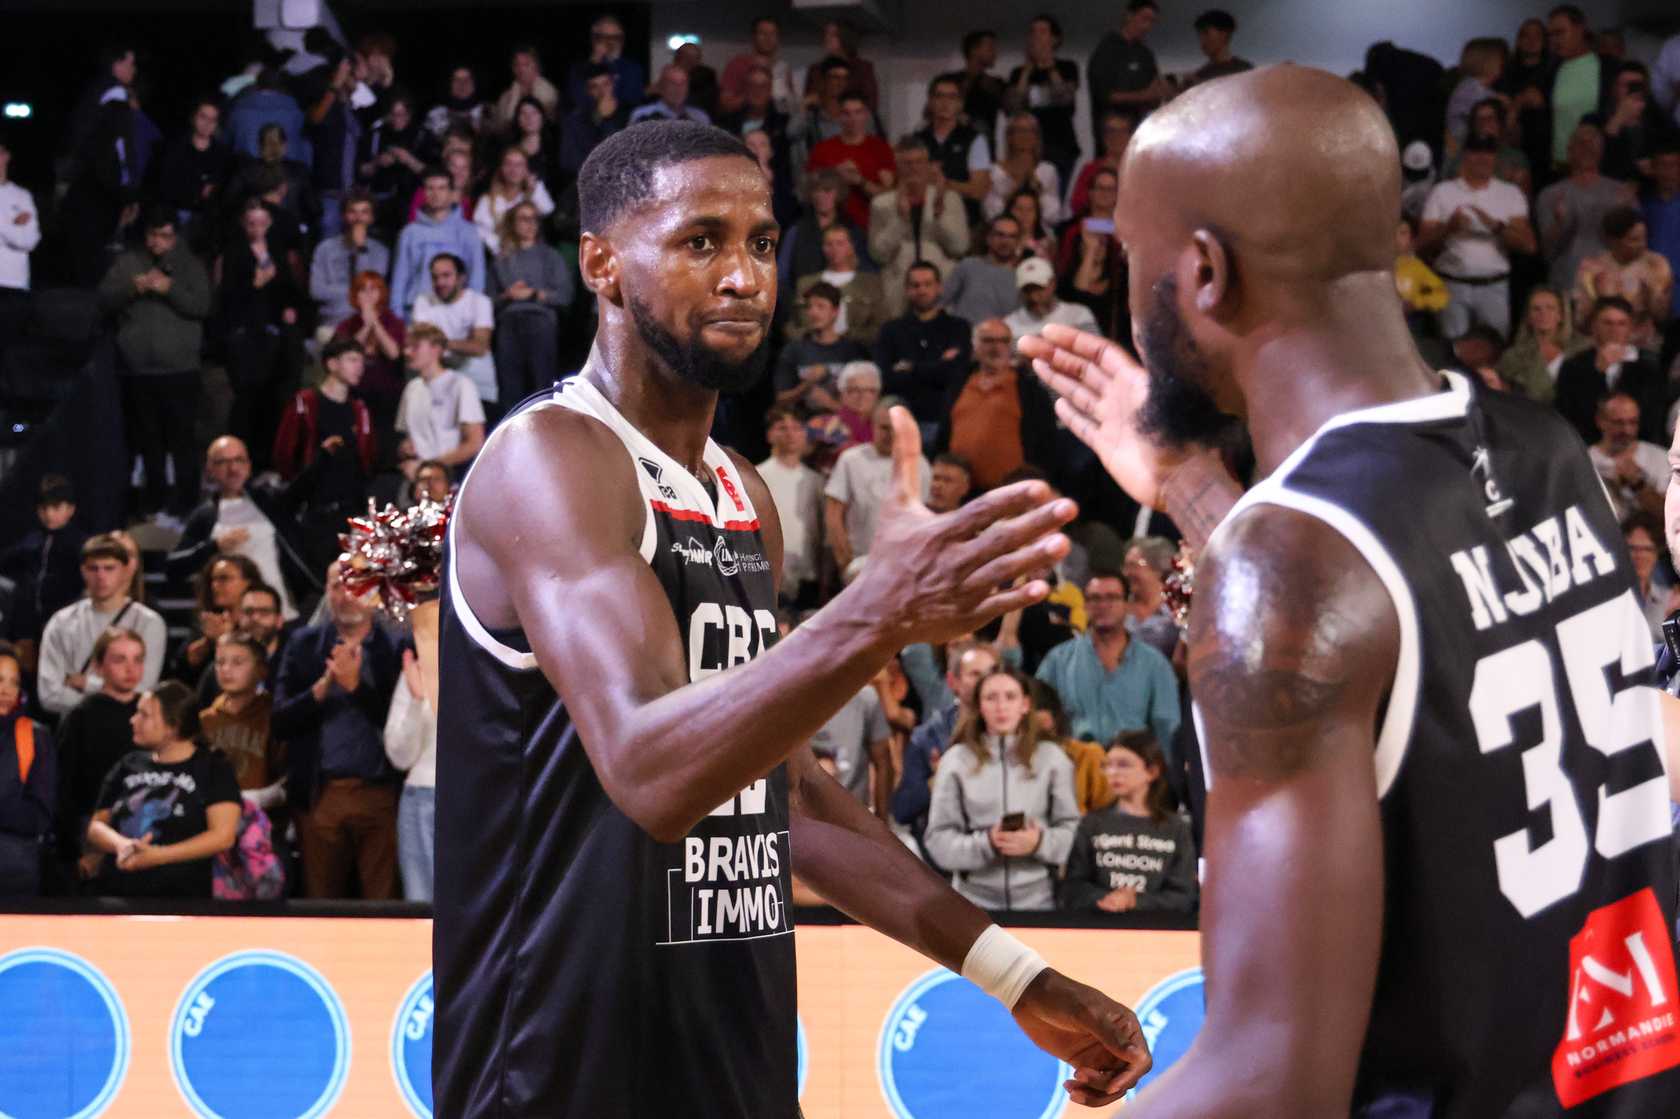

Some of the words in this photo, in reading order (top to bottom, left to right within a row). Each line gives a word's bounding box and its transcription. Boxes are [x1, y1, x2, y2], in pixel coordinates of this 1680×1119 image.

[1469, 588, 1673, 919] 35
[684, 832, 780, 884] BRAVIS
[1095, 851, 1163, 872] LONDON
[1109, 871, 1147, 893] 1992
[696, 884, 780, 936] IMMO
[1565, 1011, 1676, 1067] NORMANDIE
